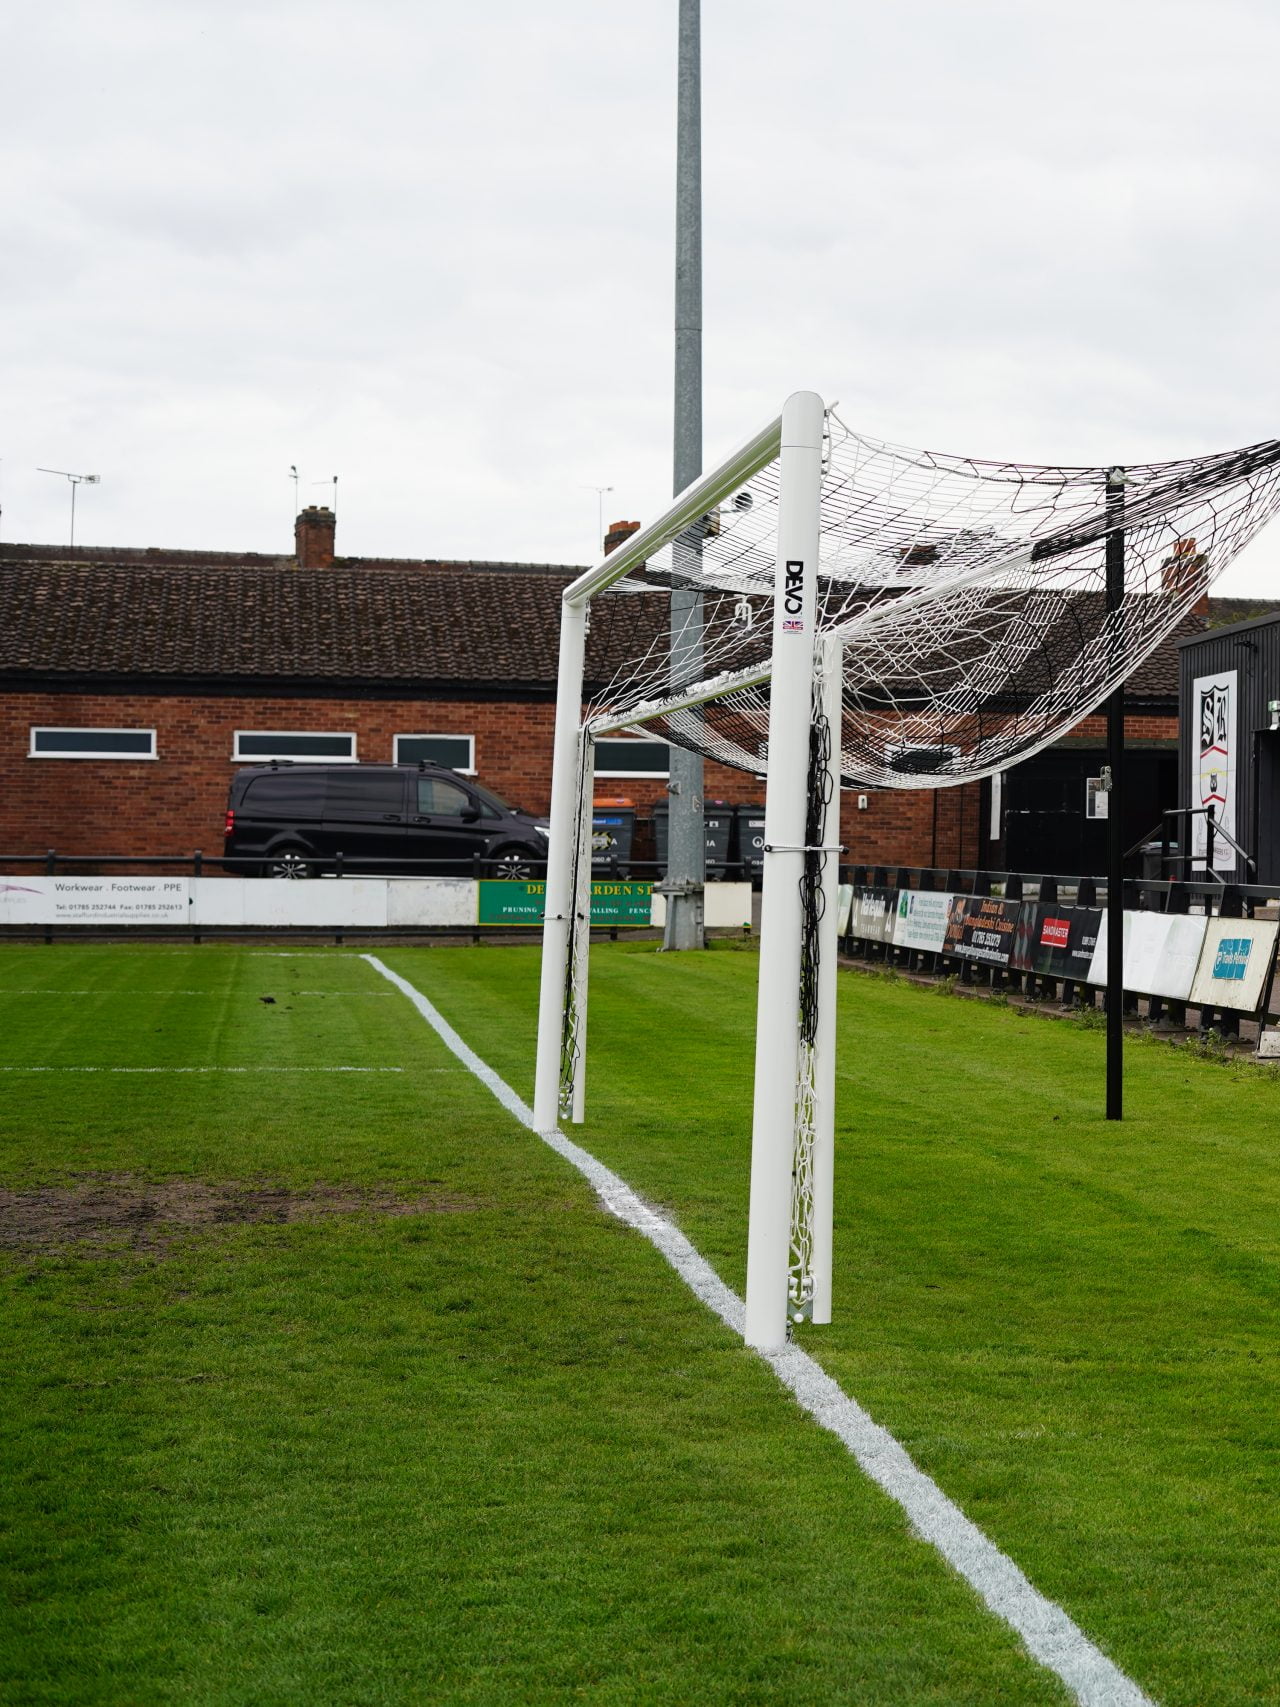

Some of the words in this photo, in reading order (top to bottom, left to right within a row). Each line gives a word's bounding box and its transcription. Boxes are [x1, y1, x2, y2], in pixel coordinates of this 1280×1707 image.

[785, 560, 803, 614] DEVO
[55, 883, 103, 892] Workwear
[111, 883, 155, 892] Footwear
[164, 883, 182, 892] PPE
[1042, 925, 1069, 938] SANDMASTER
